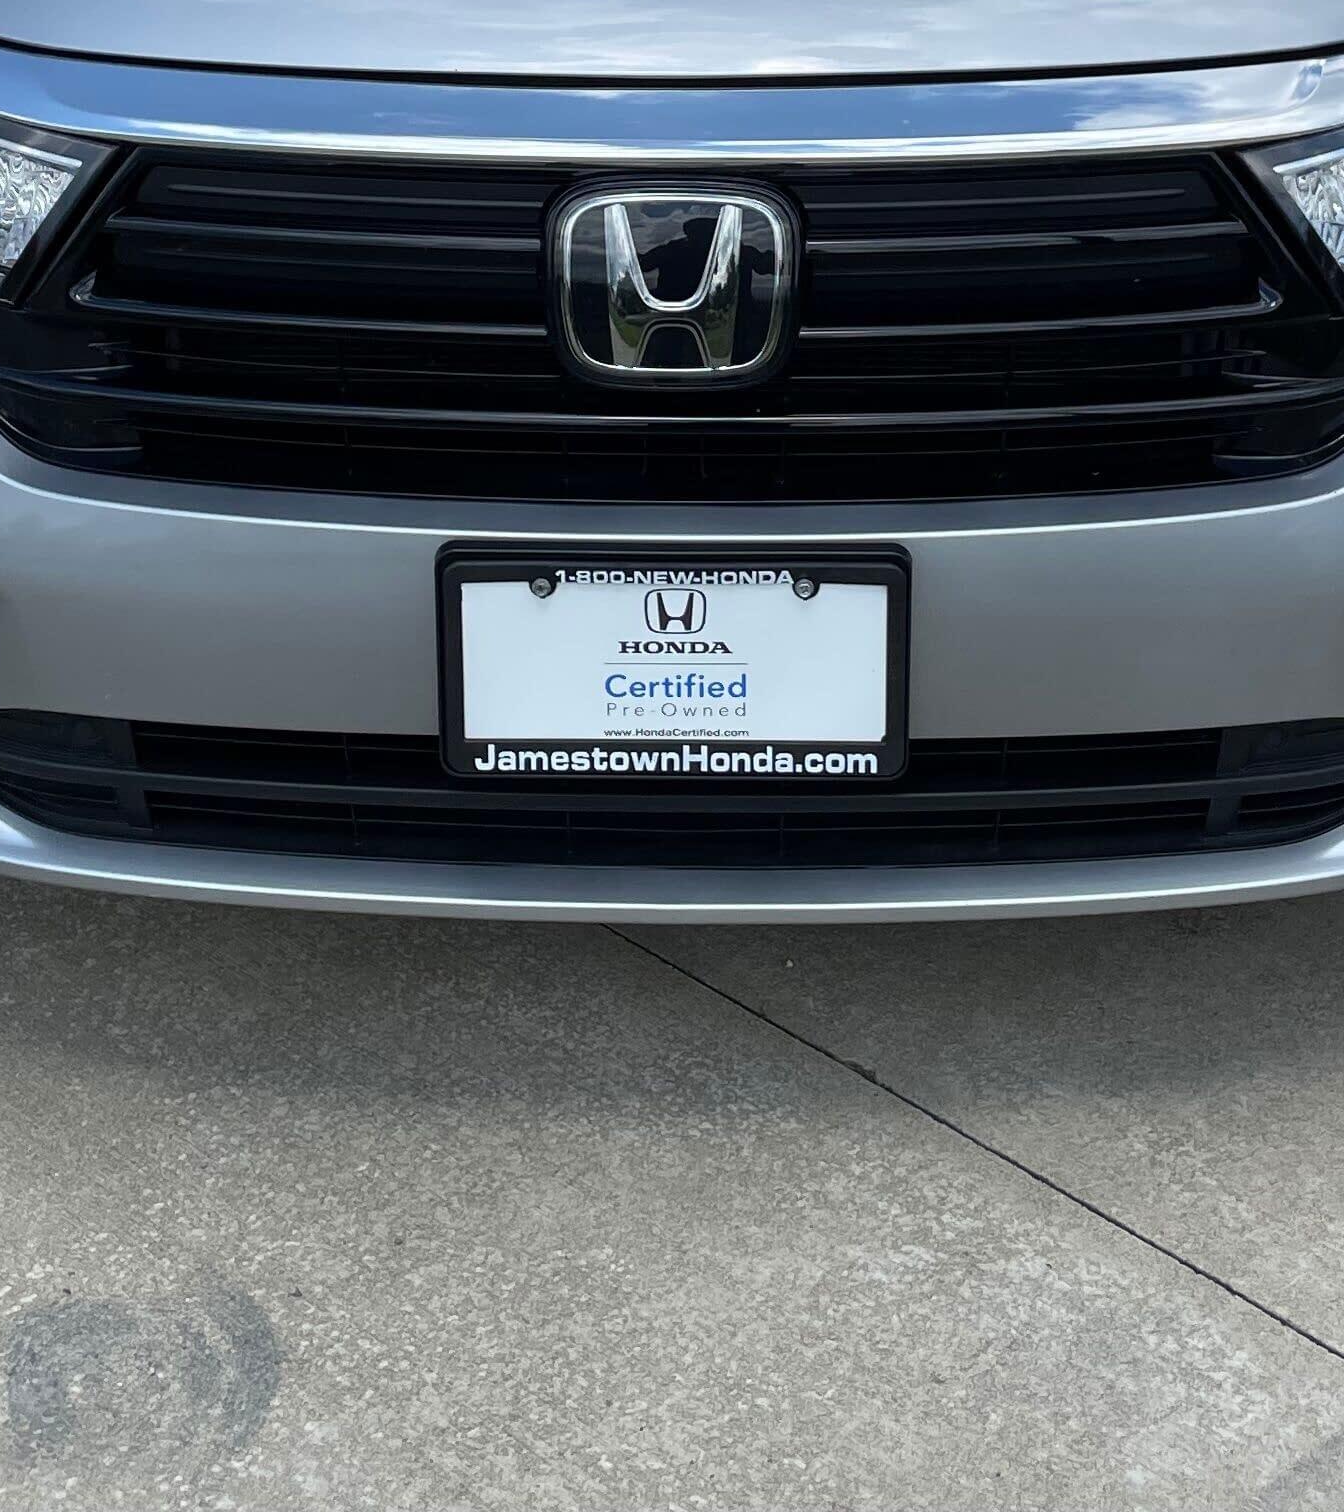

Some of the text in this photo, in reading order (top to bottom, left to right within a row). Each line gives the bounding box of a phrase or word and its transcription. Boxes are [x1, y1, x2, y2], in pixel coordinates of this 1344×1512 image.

[555, 569, 795, 586] 1-800-NEW-HONDA
[618, 640, 733, 655] HONDA
[604, 673, 747, 699] Certified
[606, 702, 747, 718] Pre-Owned
[603, 728, 750, 737] www.HondaCertified.com
[474, 744, 878, 775] JamestownHonda.com
